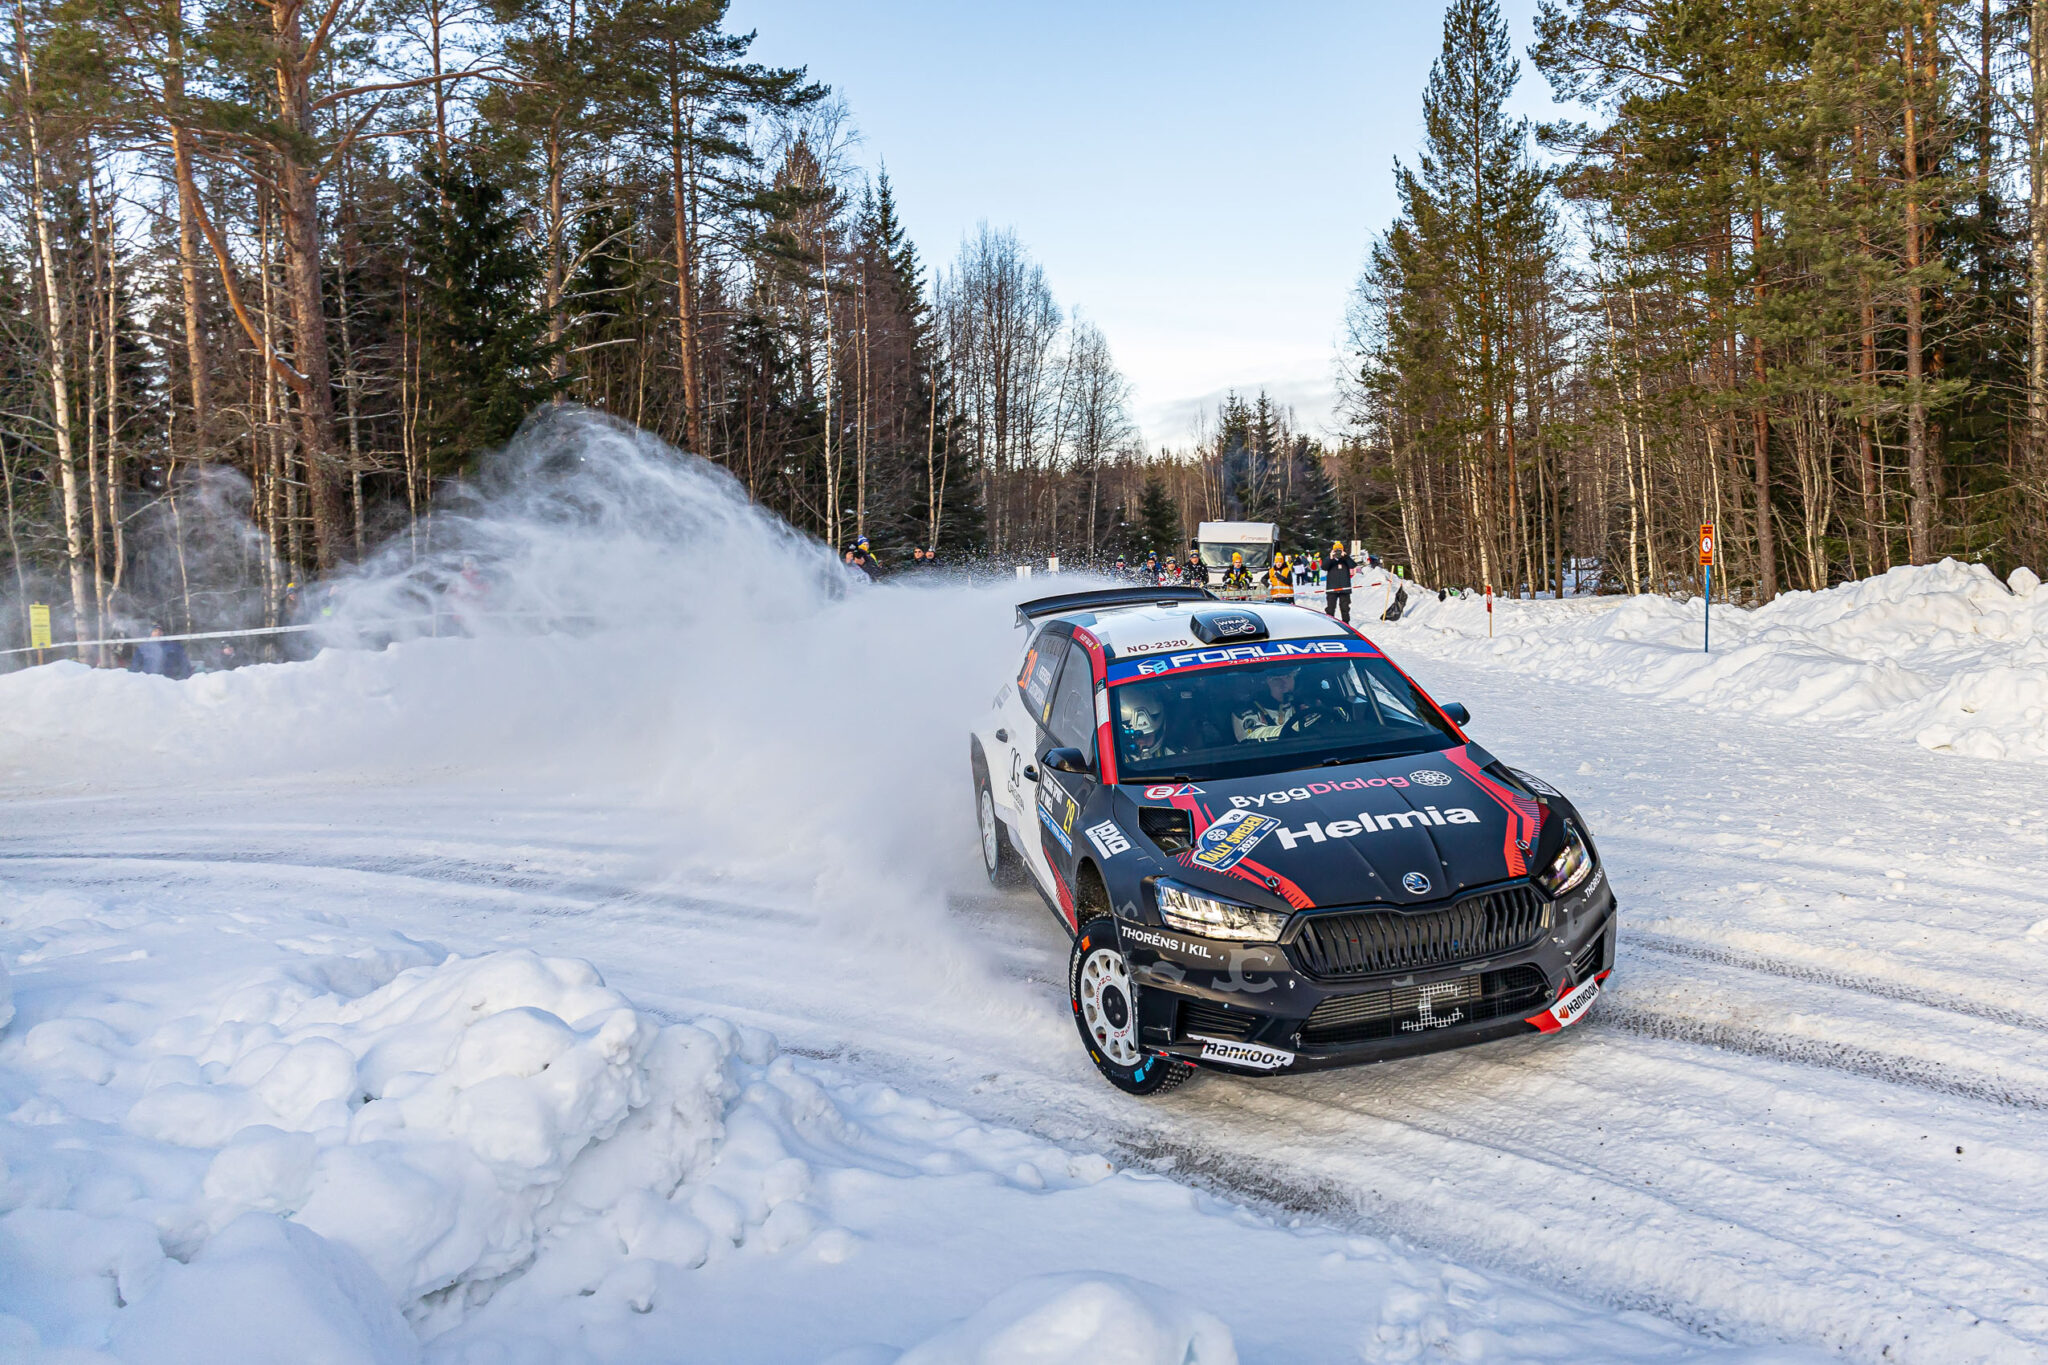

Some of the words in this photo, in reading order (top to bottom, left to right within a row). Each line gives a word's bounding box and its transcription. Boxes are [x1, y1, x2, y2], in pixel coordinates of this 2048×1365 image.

[1126, 638, 1188, 653] NO-2320
[1170, 641, 1348, 668] FORUM8
[1017, 648, 1038, 690] 29
[1228, 774, 1411, 808] ByggDialog
[1063, 798, 1075, 835] 29
[1229, 813, 1242, 822] 29
[1275, 805, 1481, 851] Helmia
[1198, 842, 1230, 863] RALLY
[1225, 815, 1266, 845] SWEDEN
[1237, 835, 1259, 853] 2025
[1121, 925, 1180, 951] THORÉNS
[1181, 941, 1187, 952] I
[1188, 945, 1212, 959] KIL
